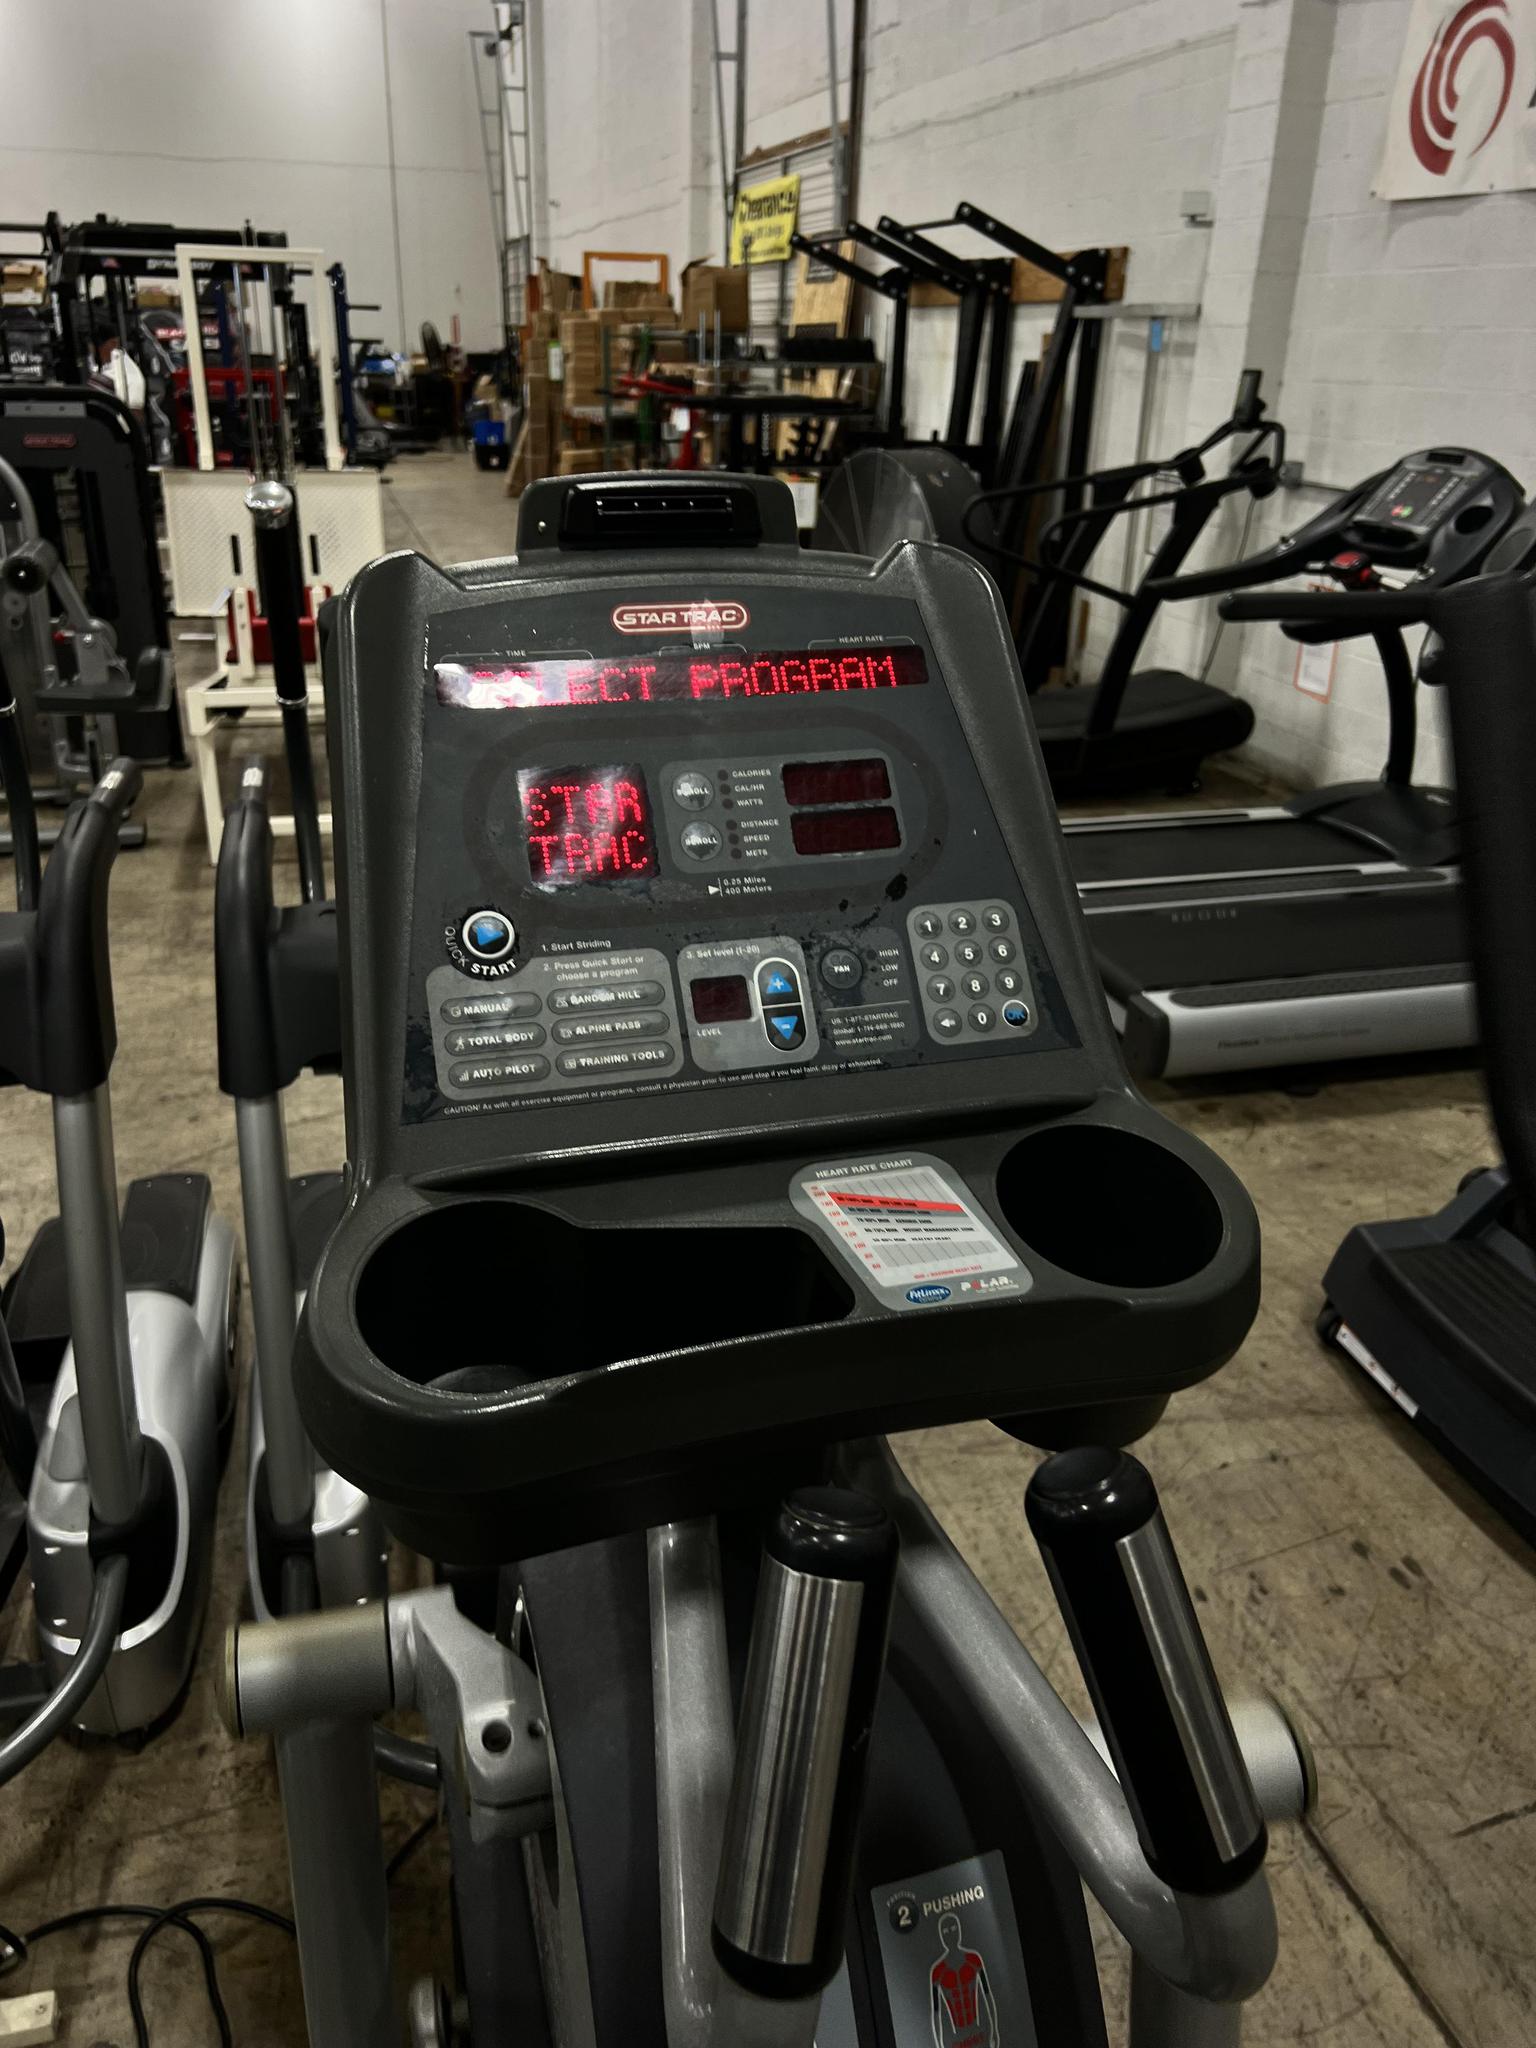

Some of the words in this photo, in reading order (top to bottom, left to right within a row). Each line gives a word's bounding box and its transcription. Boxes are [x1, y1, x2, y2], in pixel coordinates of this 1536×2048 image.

[622, 612, 677, 624] STAR
[680, 610, 737, 623] TRAC
[839, 636, 862, 644] HEART
[690, 656, 897, 698] PROGRAM
[732, 769, 772, 778] CALORIES
[735, 783, 765, 793] CAL/HR
[523, 782, 642, 827] STAR
[737, 798, 764, 807] WATTS
[740, 818, 779, 829] DISTANCE
[743, 834, 770, 843] SPEED
[529, 830, 648, 874] TRAC
[745, 849, 768, 857] METS
[744, 875, 767, 885] Miles
[743, 885, 772, 895] Meters
[924, 920, 932, 932] 1
[957, 916, 968, 929] 2
[991, 913, 1001, 926] 3
[444, 926, 470, 967] QUICK
[471, 958, 517, 977] START
[542, 944, 549, 952] 1.
[551, 941, 574, 951] Start
[576, 940, 612, 951] Striding
[697, 949, 711, 959] Set
[713, 948, 734, 957] level
[879, 949, 899, 957] HIGH
[930, 950, 941, 963] 4
[964, 947, 974, 960] 5
[998, 944, 1008, 957] 6
[554, 961, 580, 971] Press
[582, 958, 609, 970] Quick
[610, 957, 631, 966] Start
[833, 965, 850, 973] FAN
[881, 964, 898, 972] LOW
[557, 971, 590, 981] choose
[600, 967, 639, 980] program
[883, 978, 898, 986] OFF
[936, 983, 945, 995] 7
[971, 979, 981, 992] 8
[1004, 976, 1014, 989] 9
[618, 990, 640, 999] HILL
[463, 1003, 511, 1015] MANUAL
[977, 1011, 987, 1025] 0
[1007, 1009, 1026, 1020] OK
[575, 1023, 612, 1035] ALPINE
[615, 1021, 641, 1031] PASS
[697, 1028, 722, 1037] LEVEL
[468, 1035, 502, 1047] TOTAL
[505, 1032, 534, 1043] BODY
[580, 1053, 630, 1067] TRAINING
[632, 1049, 665, 1061] TOOLS
[472, 1066, 502, 1079] AUTO
[505, 1063, 537, 1075] PILOT
[493, 1101, 510, 1109] with
[511, 1099, 520, 1107] all
[669, 1079, 700, 1090] physician
[755, 1071, 770, 1079] stop
[777, 1069, 789, 1078] you
[816, 1167, 848, 1179] HEART
[851, 1163, 877, 1174] RATE
[879, 1159, 913, 1170] CHART
[898, 1905, 912, 1927] 2
[922, 1885, 985, 1917] PUSHING
